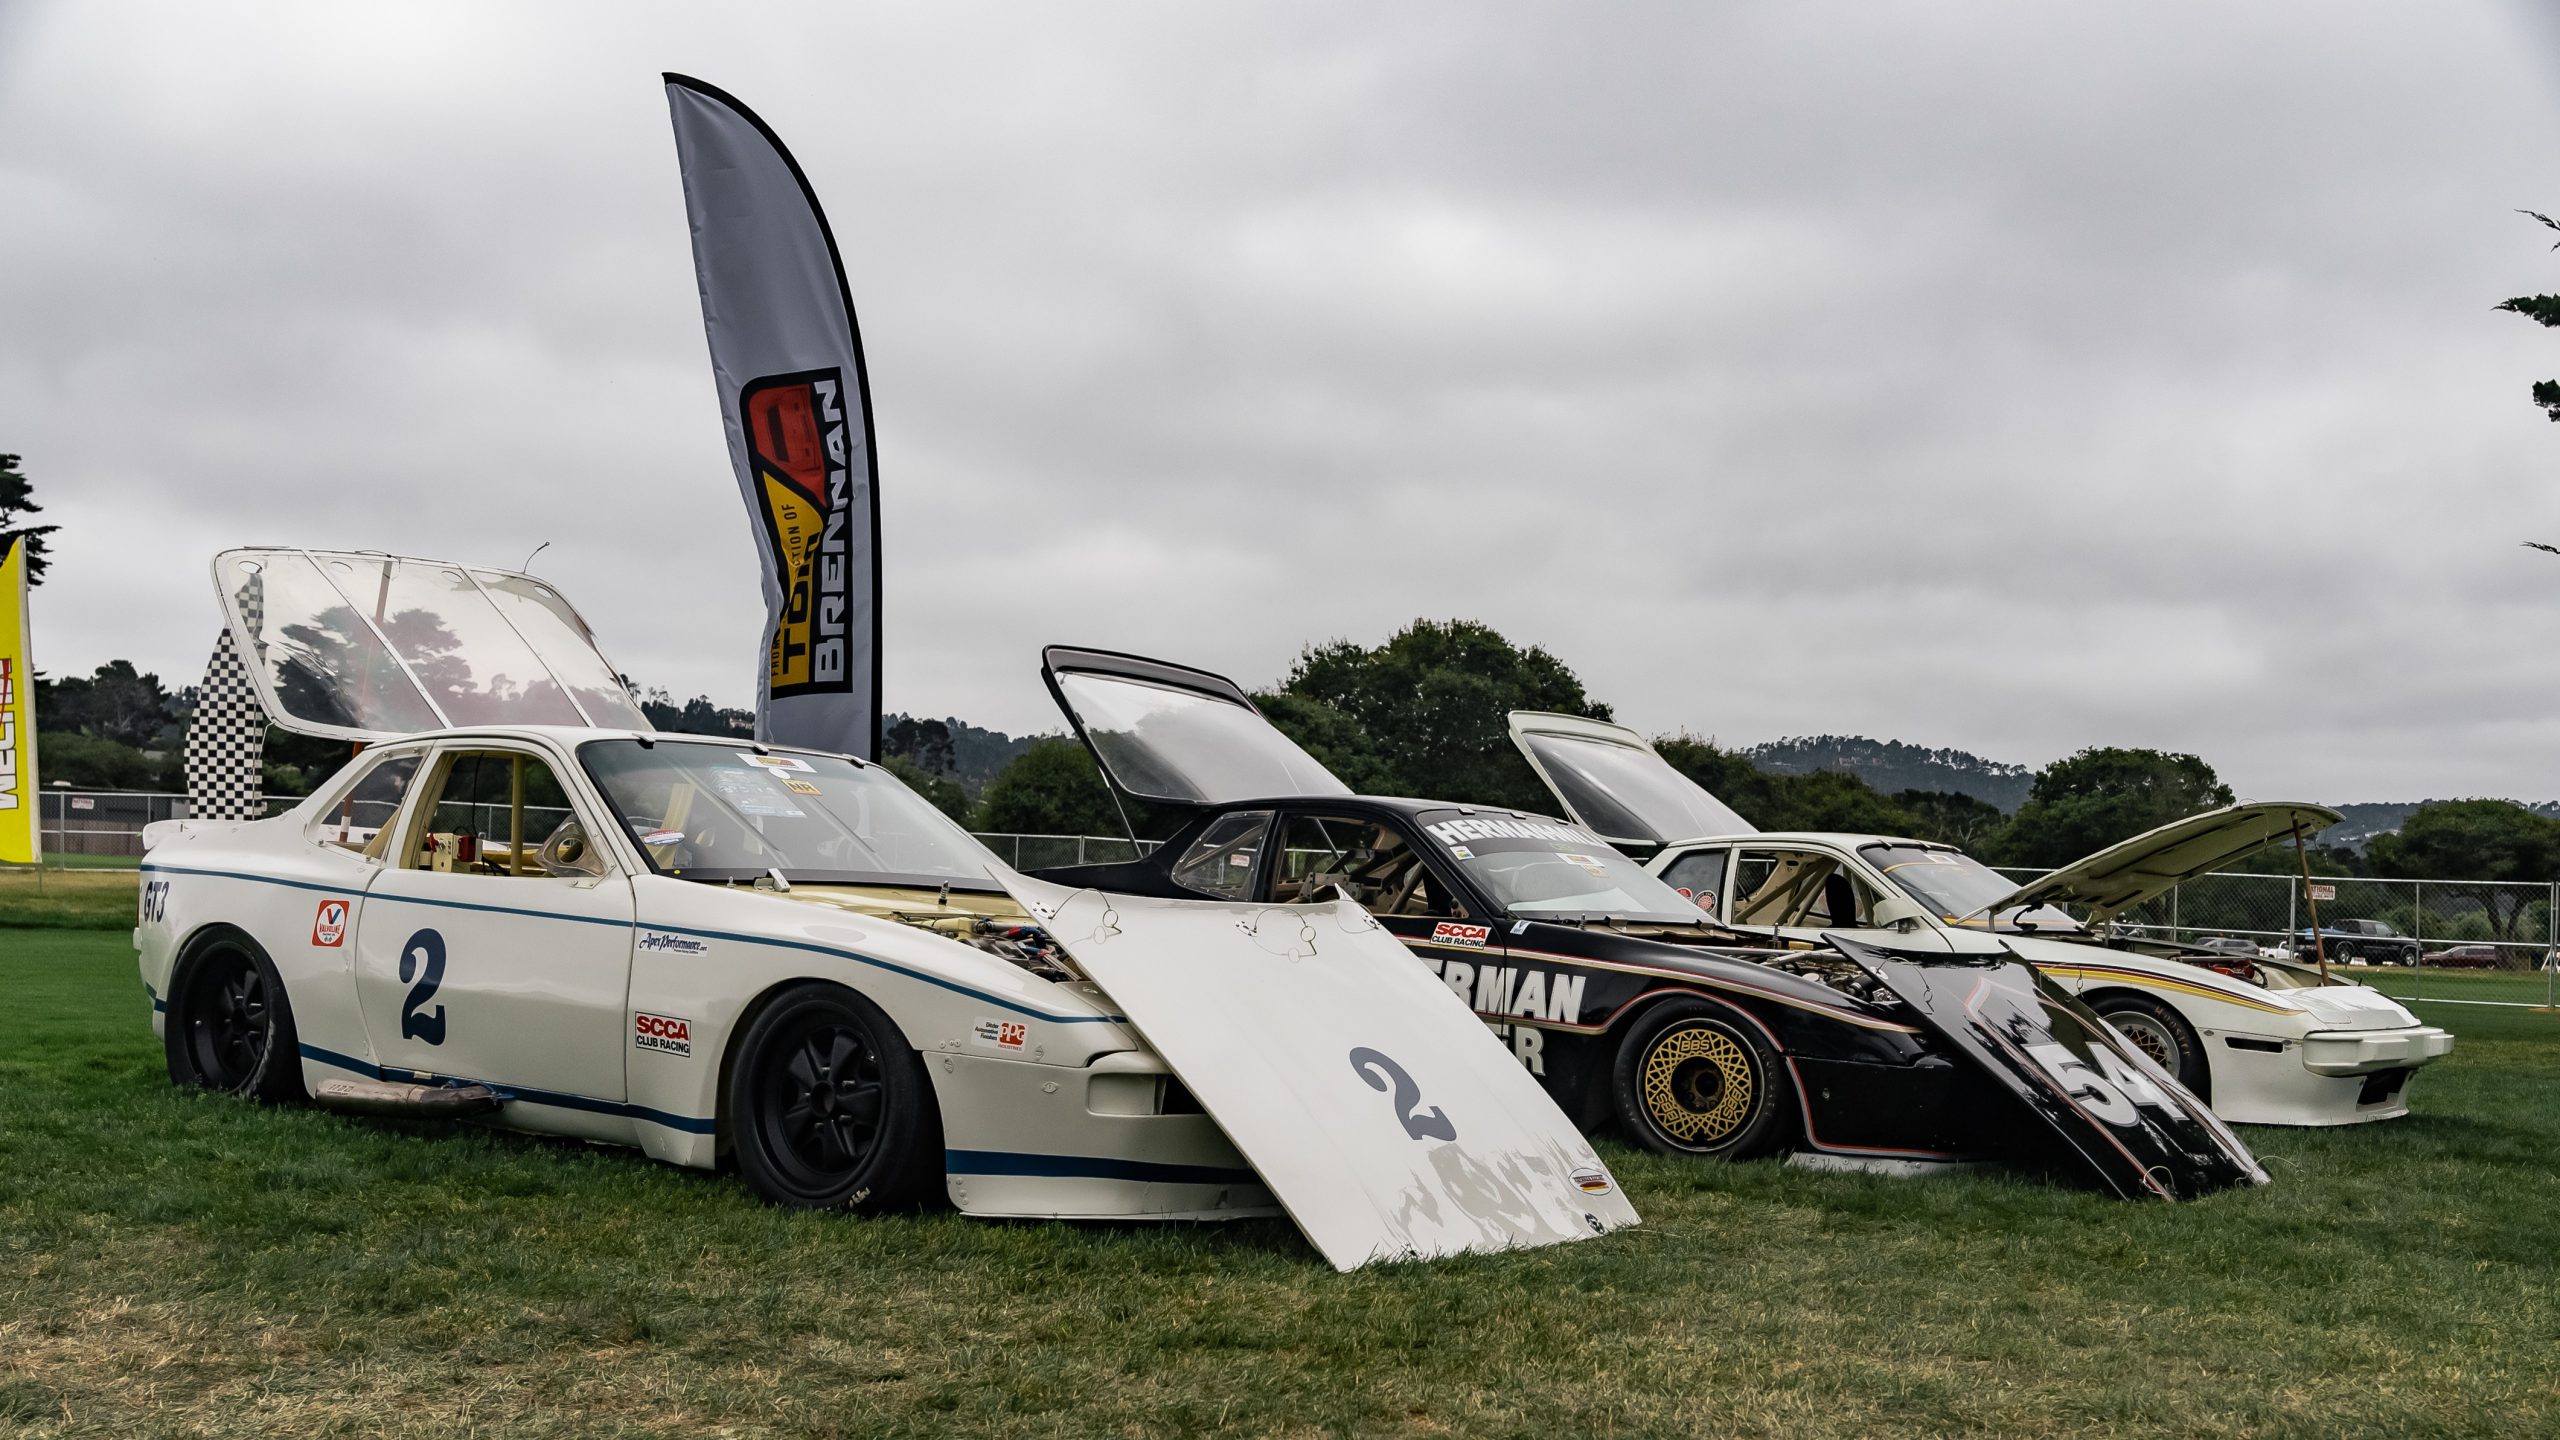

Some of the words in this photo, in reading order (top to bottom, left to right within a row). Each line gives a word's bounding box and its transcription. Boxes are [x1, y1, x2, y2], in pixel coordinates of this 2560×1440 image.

[781, 503, 798, 521] OF
[788, 526, 801, 566] CTION
[814, 379, 849, 683] BRENNAN
[144, 881, 170, 923] GT3
[1431, 935, 1453, 944] CLUB
[1453, 937, 1484, 948] RACING
[1435, 924, 1486, 939] SCCA
[399, 927, 447, 1047] 2
[1419, 957, 1587, 1024] RMAN
[636, 1015, 689, 1041] SCCA
[636, 1035, 659, 1048] CLUB
[659, 1038, 689, 1054] RACING
[1681, 1039, 1710, 1052] BBS
[1349, 1046, 1457, 1141] 2
[2020, 1040, 2190, 1128] 54
[1656, 1092, 1680, 1121] BBS
[1723, 1088, 1743, 1119] BBS
